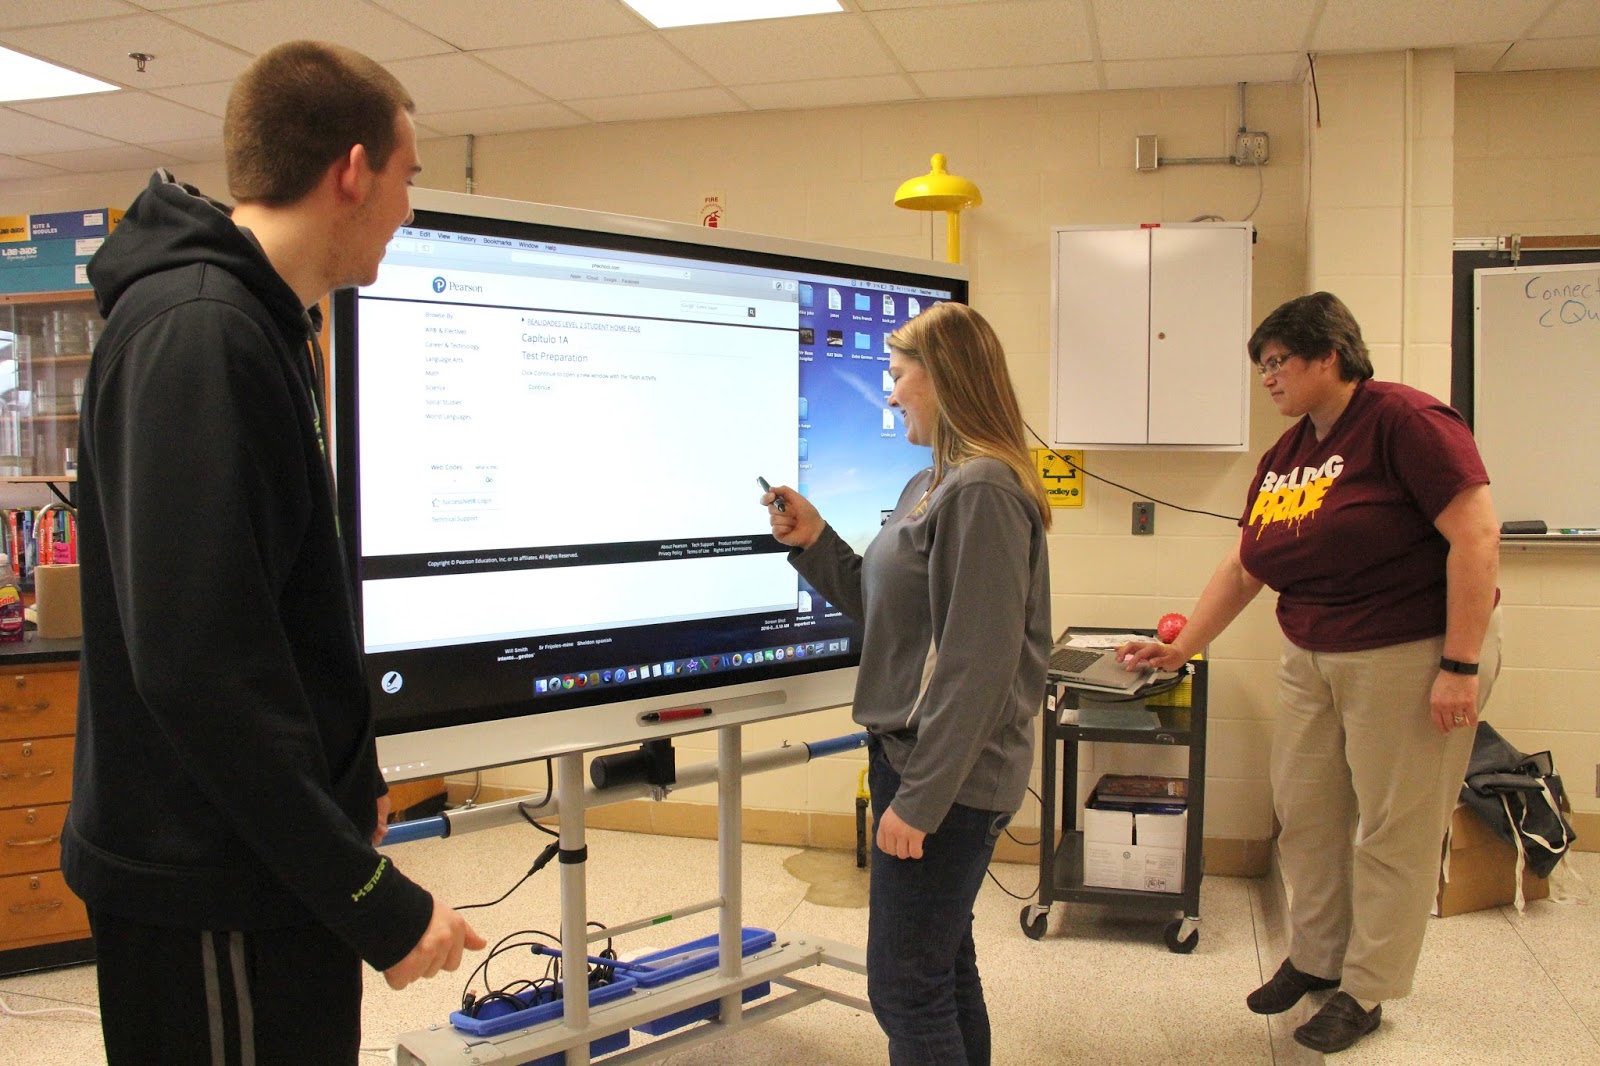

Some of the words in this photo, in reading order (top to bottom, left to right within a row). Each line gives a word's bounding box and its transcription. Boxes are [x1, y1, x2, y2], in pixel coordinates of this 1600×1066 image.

[402, 228, 413, 236] File
[419, 230, 431, 238] Edit
[437, 232, 451, 240] View
[457, 235, 477, 243] History
[483, 237, 512, 246] Bookmarks
[518, 241, 539, 249] Window
[449, 281, 483, 293] Pearson
[528, 318, 561, 328] REALIDADES
[562, 321, 578, 329] LEVEL
[584, 322, 609, 330] STUDENT
[559, 336, 569, 344] 1A
[450, 342, 480, 351] Technology
[522, 351, 538, 360] Test
[540, 352, 588, 363] Preparation
[1047, 488, 1070, 496] radley
[1248, 477, 1334, 529] PRIDE
[545, 553, 558, 561] Rights
